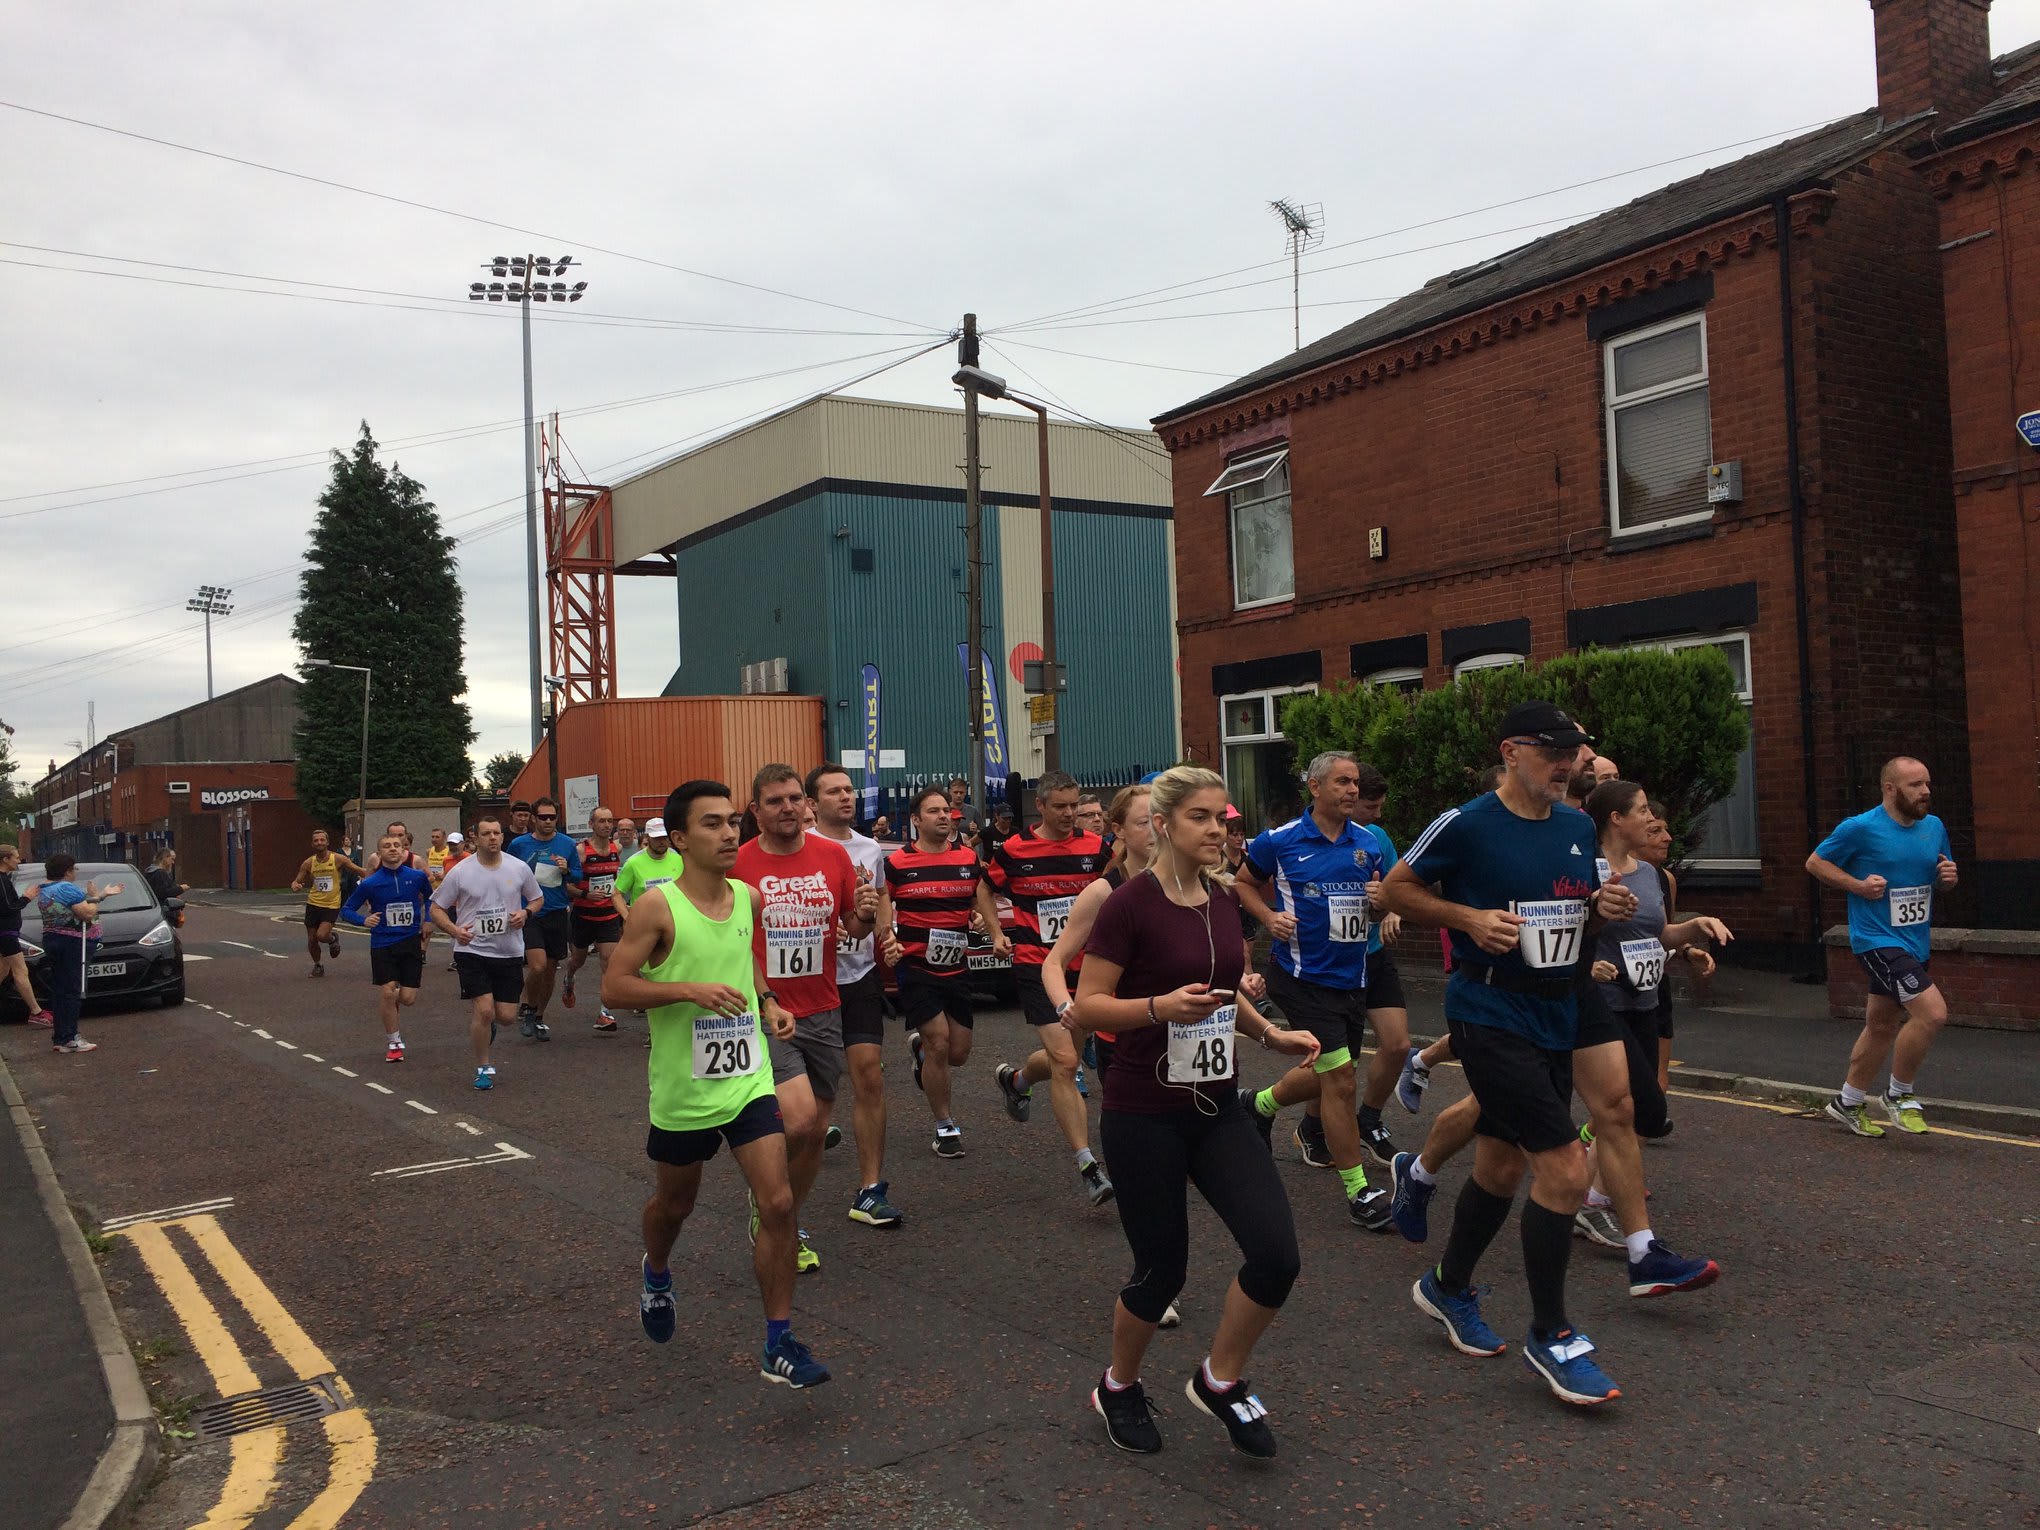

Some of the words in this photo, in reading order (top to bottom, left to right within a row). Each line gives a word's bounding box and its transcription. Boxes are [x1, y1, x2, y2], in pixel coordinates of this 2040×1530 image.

[201, 790, 269, 804] BLOSSOMS
[760, 870, 827, 894] Great
[766, 892, 799, 905] North
[800, 889, 831, 900] West
[1331, 899, 1360, 907] RUNNING
[790, 906, 831, 918] MARATHON
[1039, 900, 1069, 911] RUNNING
[1521, 905, 1562, 917] RUNNING
[1565, 904, 1582, 915] BEAR
[1899, 901, 1925, 923] 355
[393, 912, 412, 925] 149
[481, 918, 504, 934] 182
[1524, 918, 1563, 927] HATTERS
[1565, 917, 1582, 925] HALF
[768, 930, 803, 939] RUNNING
[805, 928, 821, 937] BEAR
[1342, 915, 1366, 940] 104
[1539, 928, 1577, 963] 177
[780, 947, 812, 974] 161
[931, 944, 961, 964] 378
[102, 964, 124, 975] KGV
[1635, 959, 1660, 987] 233
[695, 1018, 736, 1030] RUNNING
[737, 1015, 755, 1027] BEAR
[697, 1030, 736, 1040] HATTERS
[737, 1028, 755, 1037] HALF
[1173, 1028, 1216, 1040] HATTERS
[705, 1038, 751, 1074] 230
[1192, 1037, 1228, 1078] 48
